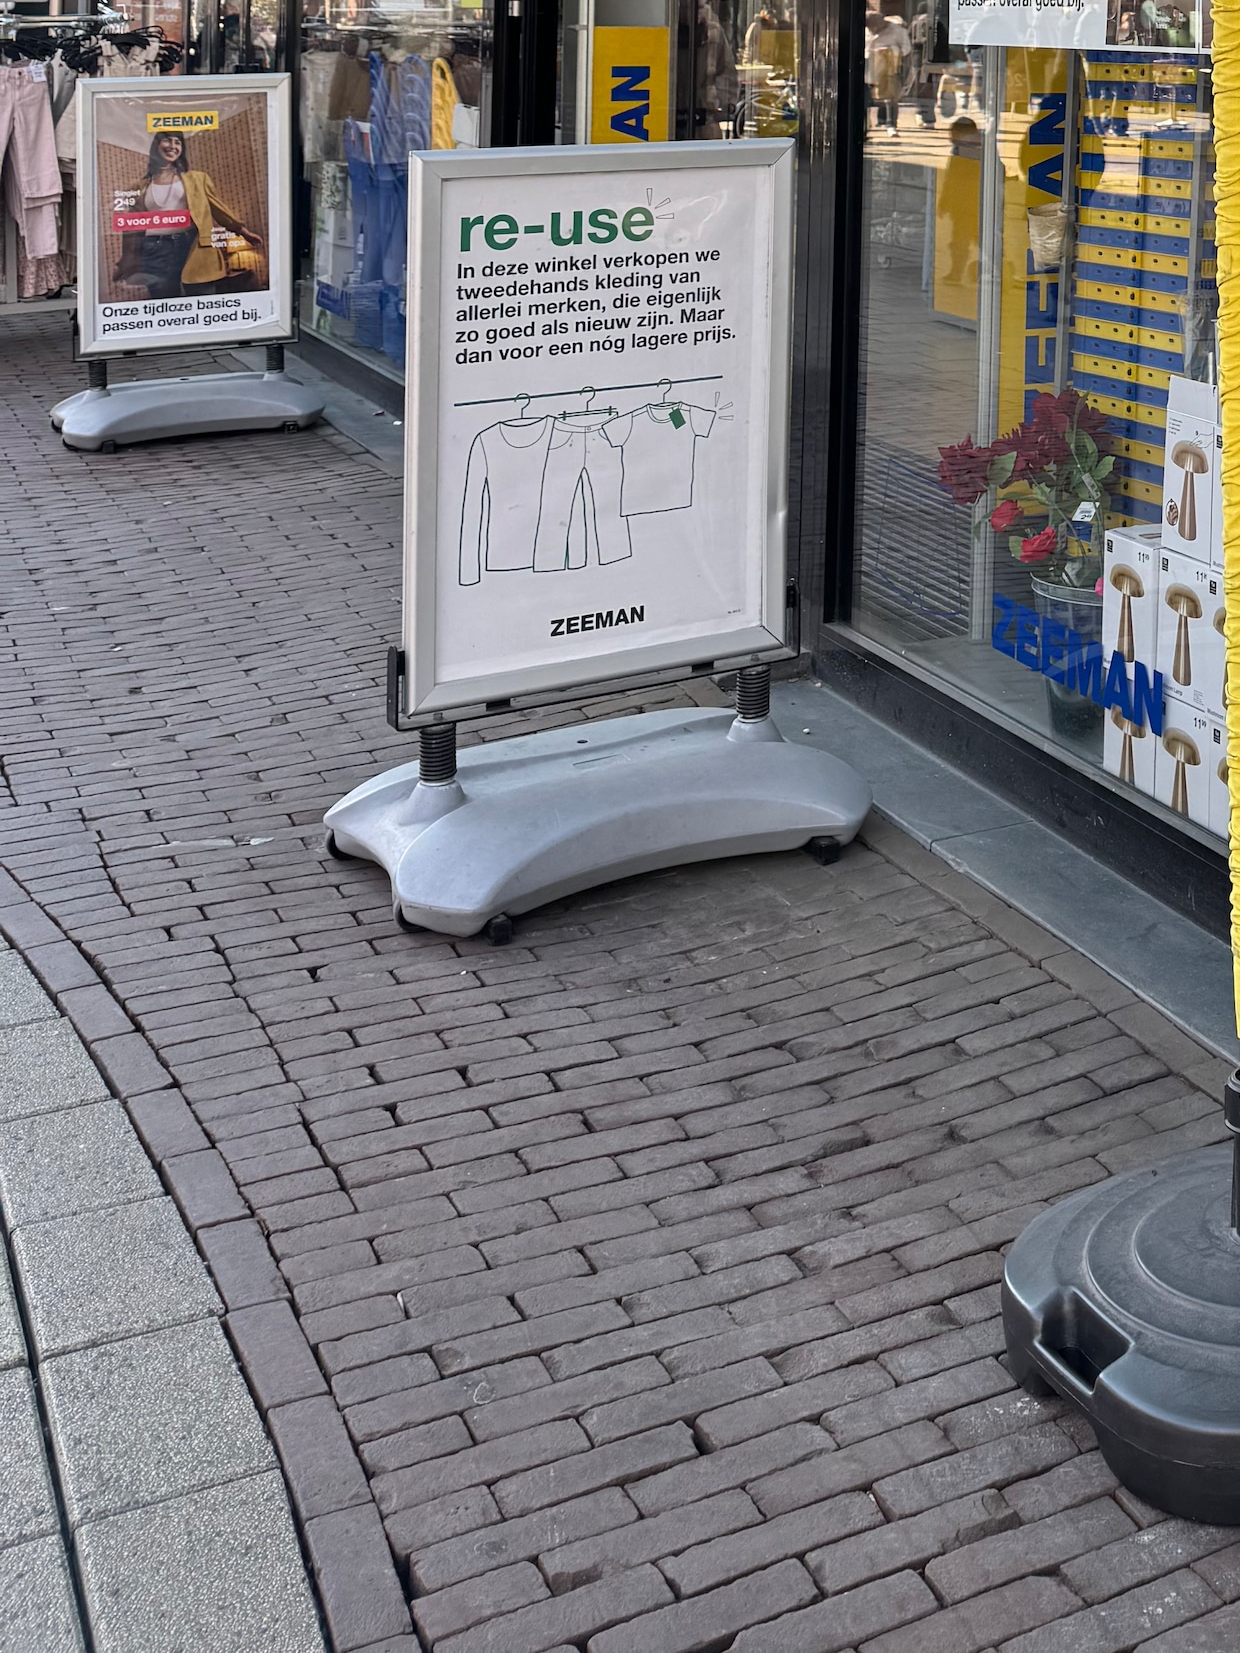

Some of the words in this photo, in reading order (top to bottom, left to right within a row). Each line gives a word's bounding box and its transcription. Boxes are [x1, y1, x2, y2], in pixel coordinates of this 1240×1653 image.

[152, 115, 214, 128] ZEEMAN
[117, 218, 125, 227] 3
[126, 216, 151, 226] voor
[152, 215, 161, 224] 6
[162, 214, 187, 224] euro
[460, 206, 655, 252] re-use
[457, 263, 475, 279] In
[482, 260, 529, 277] deze
[535, 254, 597, 274] winkel
[603, 250, 689, 271] verkopen
[695, 249, 721, 262] we
[456, 278, 589, 301] tweedehands
[595, 271, 663, 290] kleding
[669, 269, 701, 285] van
[102, 306, 139, 318] Onze
[143, 302, 193, 316] tijdloze
[197, 298, 241, 310] basics
[456, 301, 522, 322] allerlei
[528, 298, 607, 317] merken,
[612, 293, 641, 309] die
[646, 286, 721, 308] eigenlijk
[102, 320, 153, 334] passen
[157, 314, 199, 327] overal
[203, 310, 238, 325] goed
[242, 308, 262, 322] bij.
[455, 329, 479, 344] zo
[485, 321, 536, 344] goed
[541, 319, 569, 336] als
[575, 314, 631, 333] nieuw
[636, 309, 675, 330] zijn.
[680, 306, 725, 324] Maar
[455, 347, 492, 365] dan
[498, 345, 544, 361] voor
[549, 340, 583, 356] een
[589, 335, 625, 354] nóg
[631, 331, 688, 350] lagere
[693, 325, 736, 346] prijs.
[550, 605, 645, 637] ZEEMAN
[991, 592, 1163, 737] ZEEMAN
